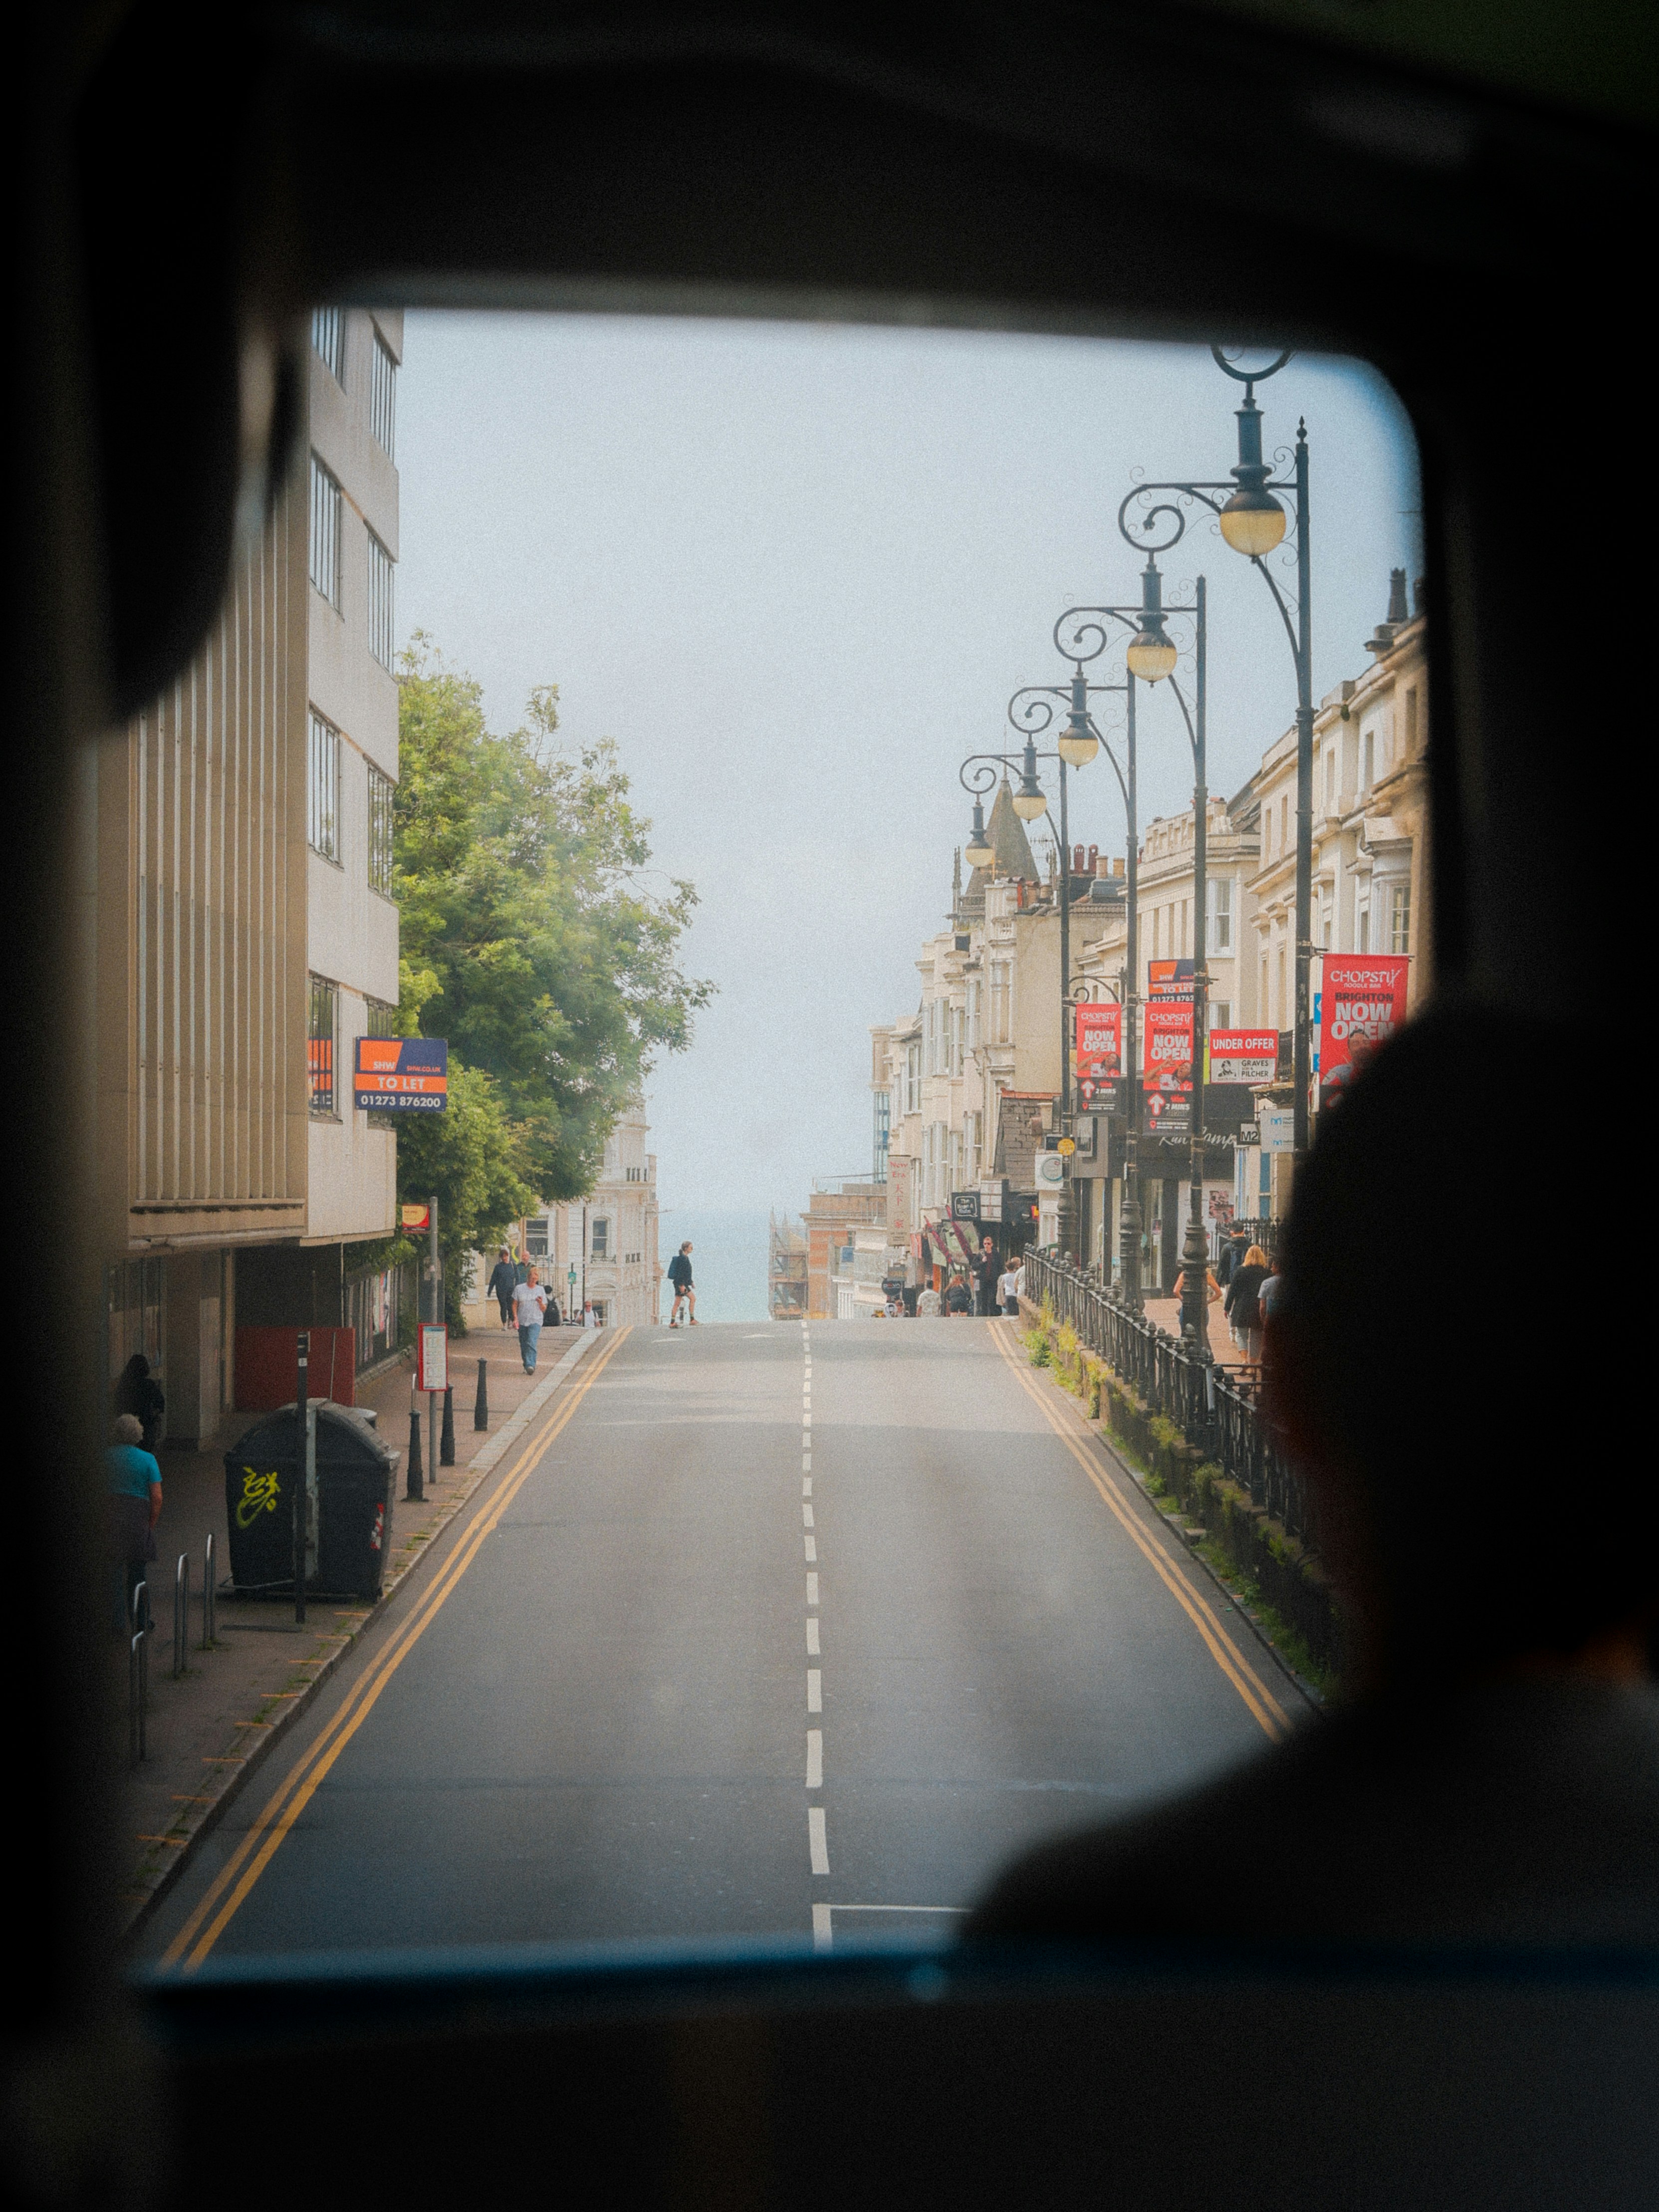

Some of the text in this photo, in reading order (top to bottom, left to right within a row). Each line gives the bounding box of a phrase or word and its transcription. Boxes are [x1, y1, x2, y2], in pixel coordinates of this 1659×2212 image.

[1335, 992, 1394, 1001] BRIGHTON
[1336, 1002, 1393, 1021] NOW
[1085, 1030, 1115, 1041] NOW
[1331, 1020, 1395, 1040] OPEN
[1083, 1041, 1116, 1052] OPEN
[1154, 1034, 1189, 1047] NOW
[1212, 1038, 1274, 1050] UNDER OFFER
[1151, 1047, 1190, 1060] OPEN
[373, 1061, 396, 1070] SHW
[378, 1077, 425, 1090] TO LET
[361, 1095, 441, 1107] 01273 876200
[1241, 1131, 1258, 1141] M2
